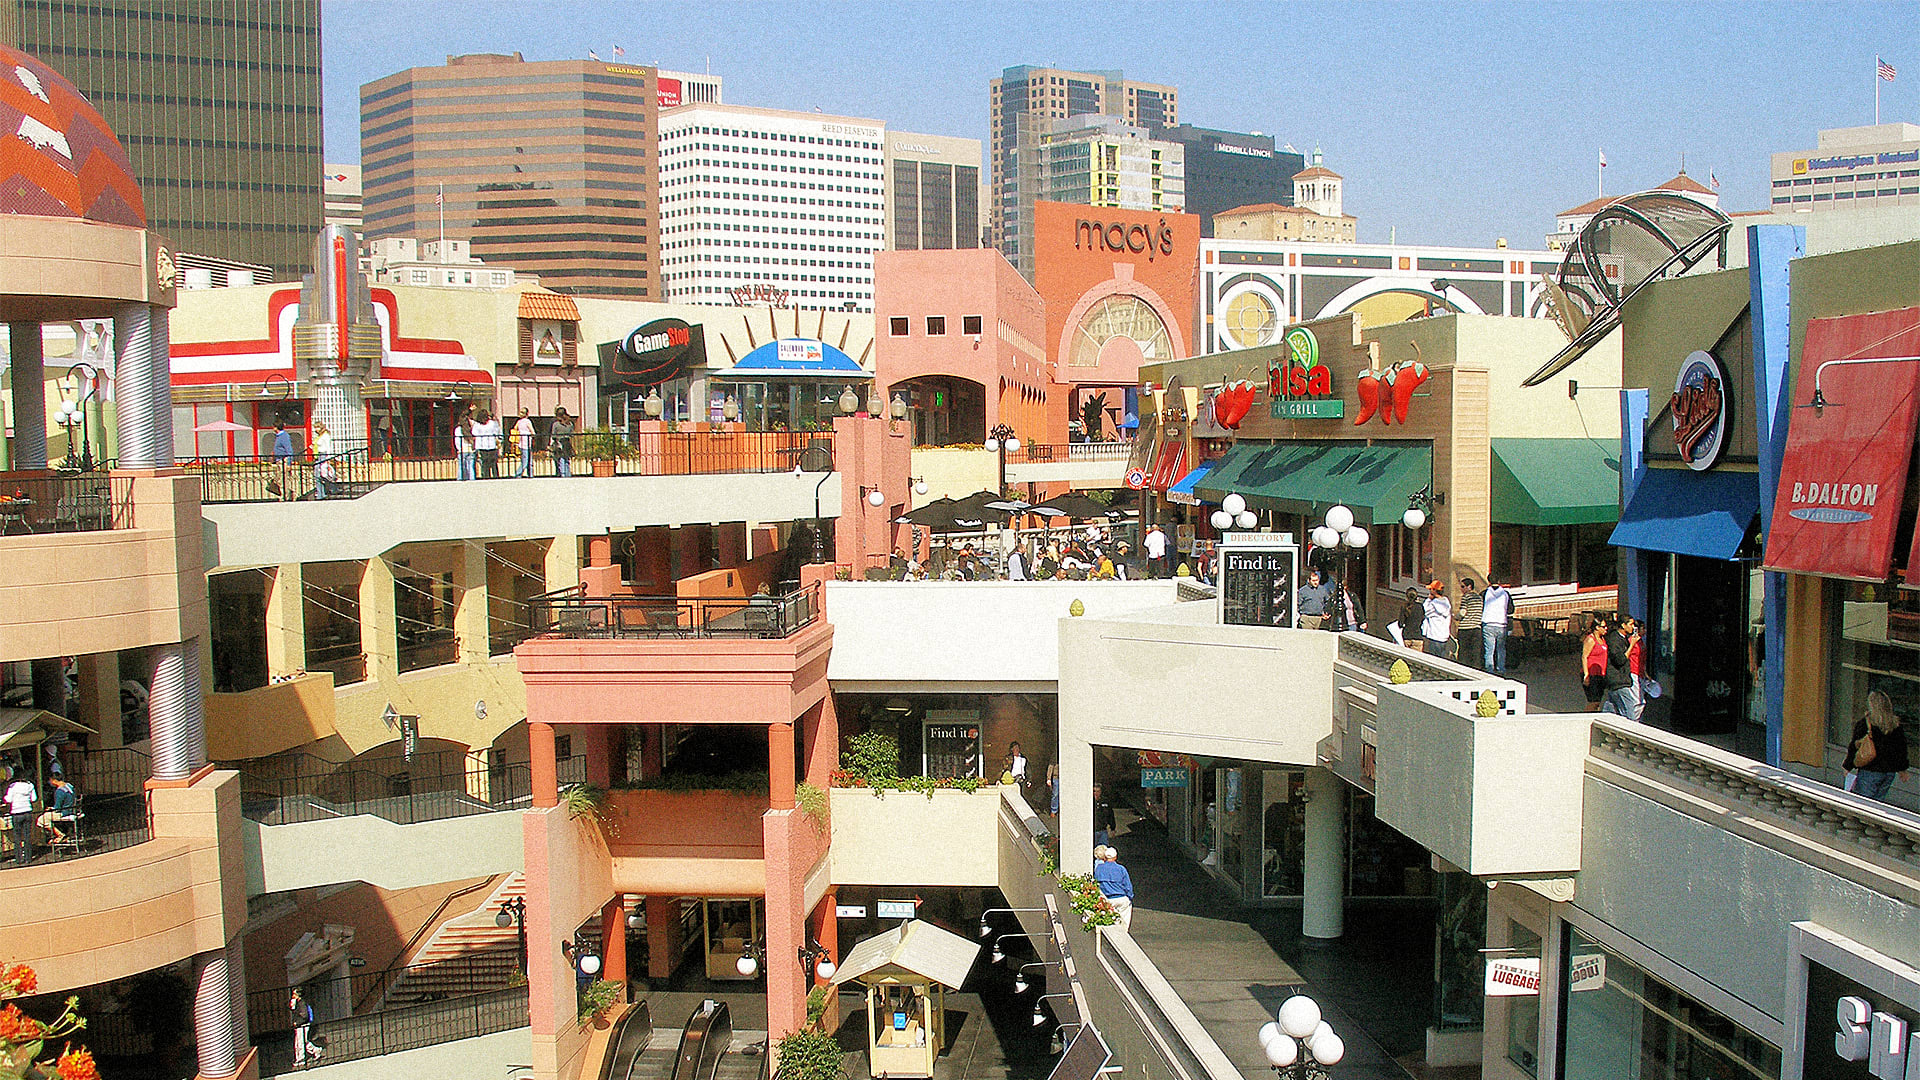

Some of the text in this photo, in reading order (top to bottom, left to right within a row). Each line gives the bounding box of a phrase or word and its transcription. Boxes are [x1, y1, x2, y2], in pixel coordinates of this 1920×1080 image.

[822, 124, 878, 137] REED ELSEVIER
[1218, 143, 1271, 158] MERRILL LYNCH
[1808, 148, 1920, 170] Washington Mutual
[1075, 217, 1174, 262] macy's
[633, 327, 690, 354] GameStop
[1289, 403, 1318, 415] GRILL
[1791, 482, 1878, 506] B.DALTON
[1230, 534, 1286, 542] DIRECTORY
[1228, 555, 1281, 571] Find it.
[930, 727, 957, 738] Find
[1145, 770, 1186, 780] PARK
[880, 903, 913, 913] PARK
[1492, 969, 1540, 991] LUGGAGE
